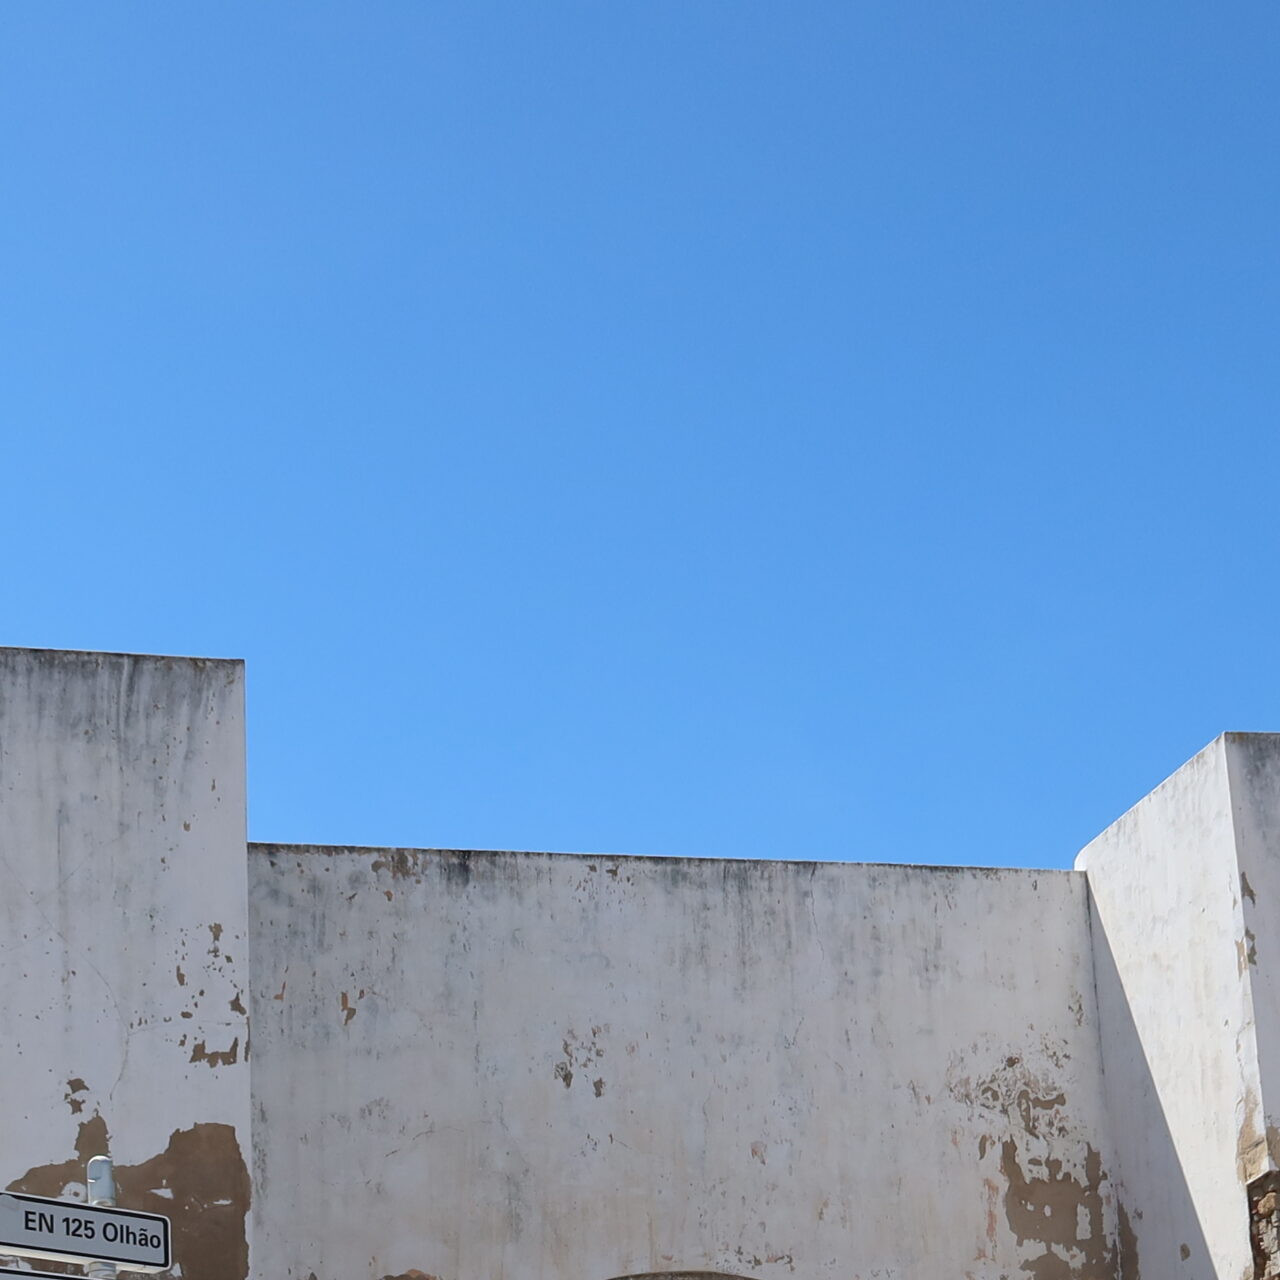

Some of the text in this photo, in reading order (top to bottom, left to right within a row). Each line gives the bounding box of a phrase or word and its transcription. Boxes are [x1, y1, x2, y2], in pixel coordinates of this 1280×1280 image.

[24, 1210, 162, 1249] EN 125 Olhão
